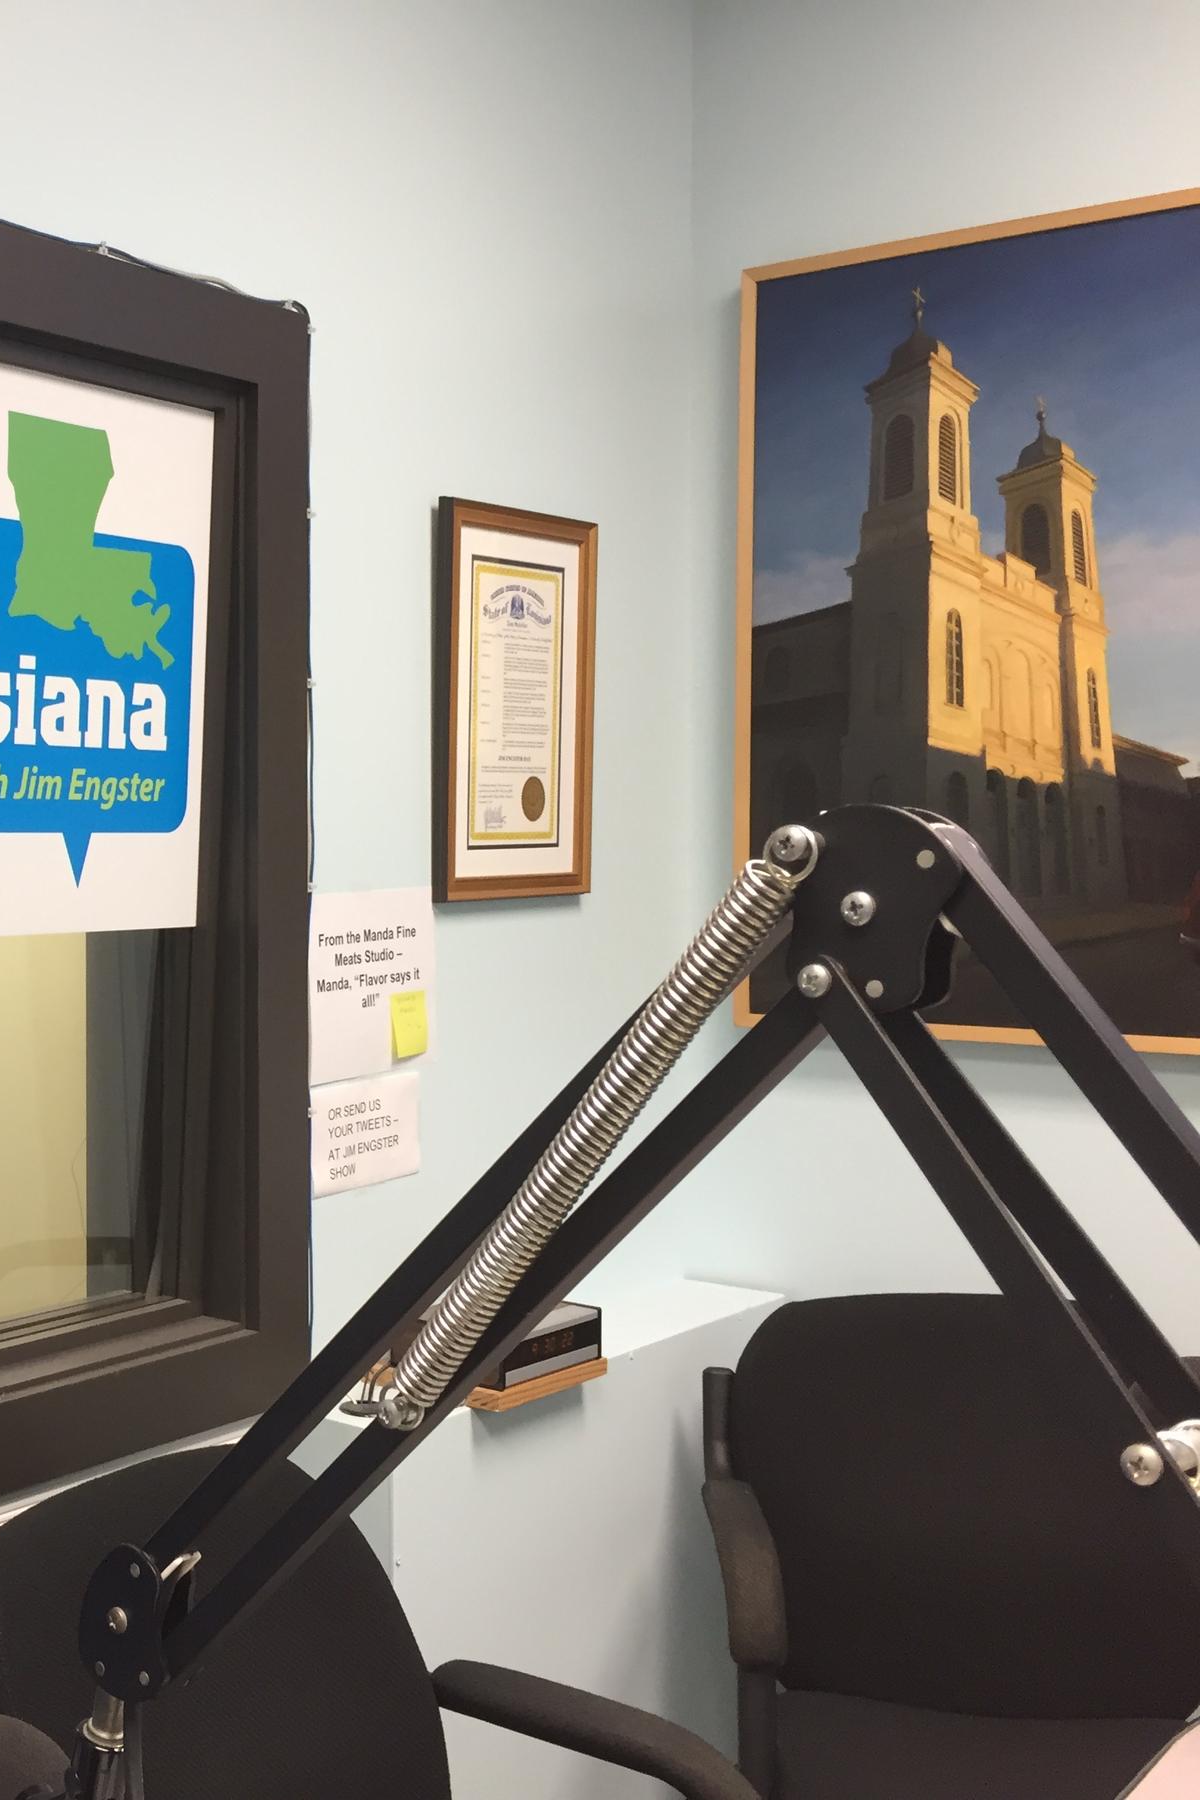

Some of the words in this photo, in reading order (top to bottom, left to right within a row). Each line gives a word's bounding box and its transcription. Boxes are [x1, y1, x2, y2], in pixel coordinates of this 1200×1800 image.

[13, 766, 62, 800] Jim
[68, 768, 165, 810] Engster
[318, 933, 344, 947] From
[346, 931, 361, 944] the
[363, 928, 394, 943] Manda
[396, 926, 416, 939] Fine
[334, 952, 362, 967] Meats
[364, 948, 394, 963] Studio
[316, 977, 352, 993] Manda,
[390, 971, 411, 985] says
[413, 968, 420, 980] it
[328, 1107, 342, 1120] OR
[343, 1101, 366, 1117] SEND
[369, 1098, 381, 1112] US
[328, 1123, 353, 1138] YOUR
[356, 1115, 391, 1132] TWEETS
[328, 1147, 341, 1160] AT
[343, 1144, 356, 1158] JIM
[357, 1134, 399, 1154] ENGSTER
[329, 1163, 356, 1180] SHOW
